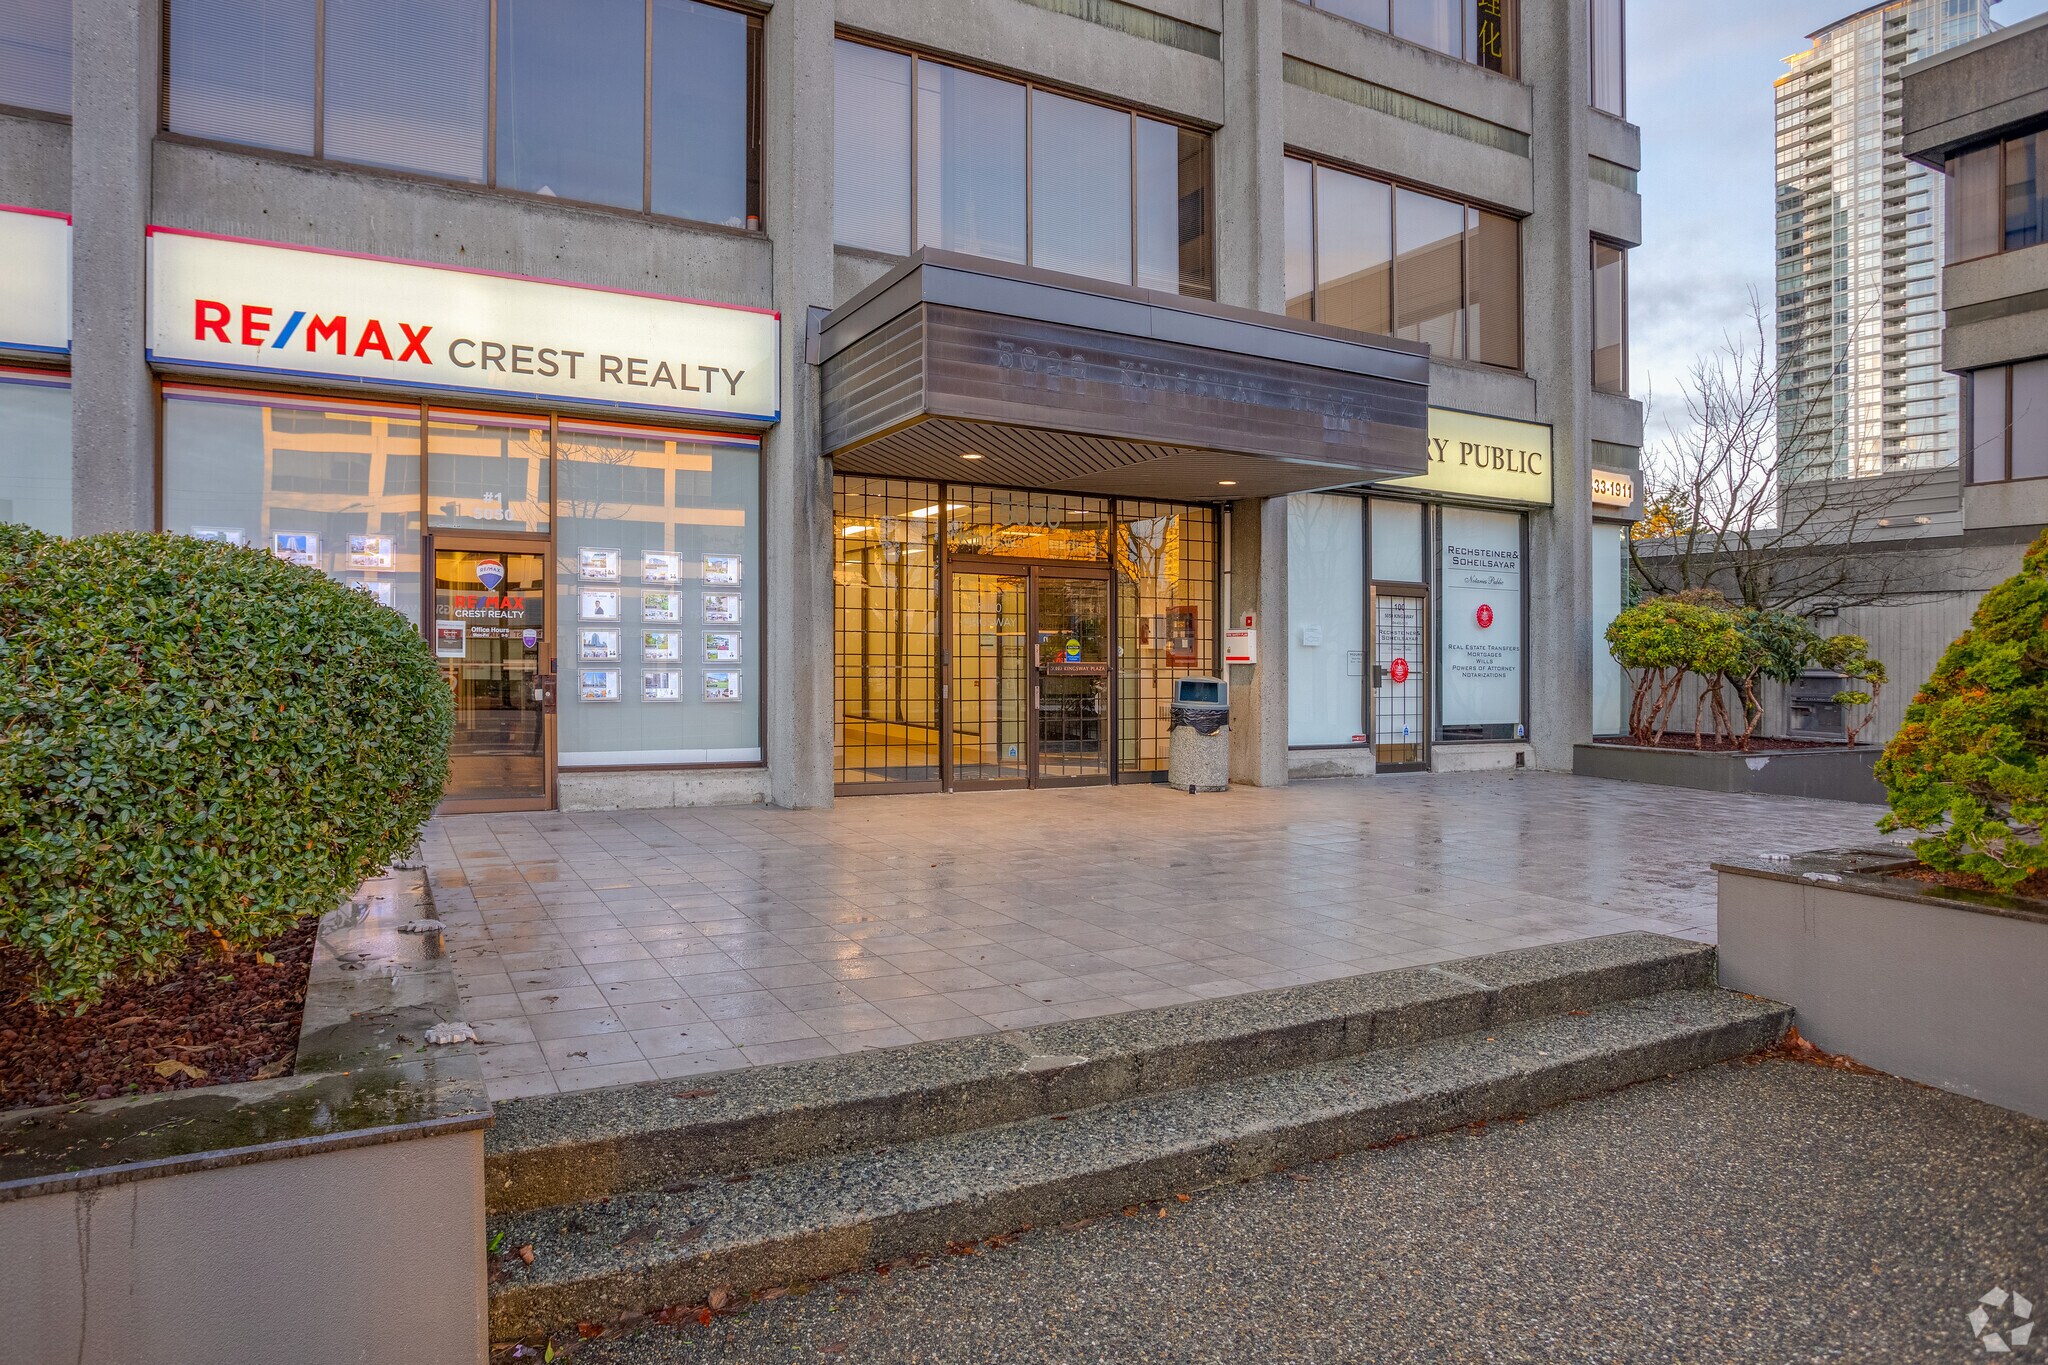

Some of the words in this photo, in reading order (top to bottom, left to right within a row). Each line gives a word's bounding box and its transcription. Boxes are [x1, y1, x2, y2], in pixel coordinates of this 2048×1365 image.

[194, 298, 434, 365] RE/MAX
[448, 337, 585, 380] CREST
[599, 354, 746, 397] REALTY
[1459, 441, 1543, 476] PUBLIC
[483, 491, 502, 504] #1
[1452, 556, 1516, 569] SOHEILSAYAR
[455, 595, 524, 610] RE/MAX
[454, 609, 487, 619] CREST
[488, 610, 525, 619] REALTY
[490, 626, 510, 634] Hours
